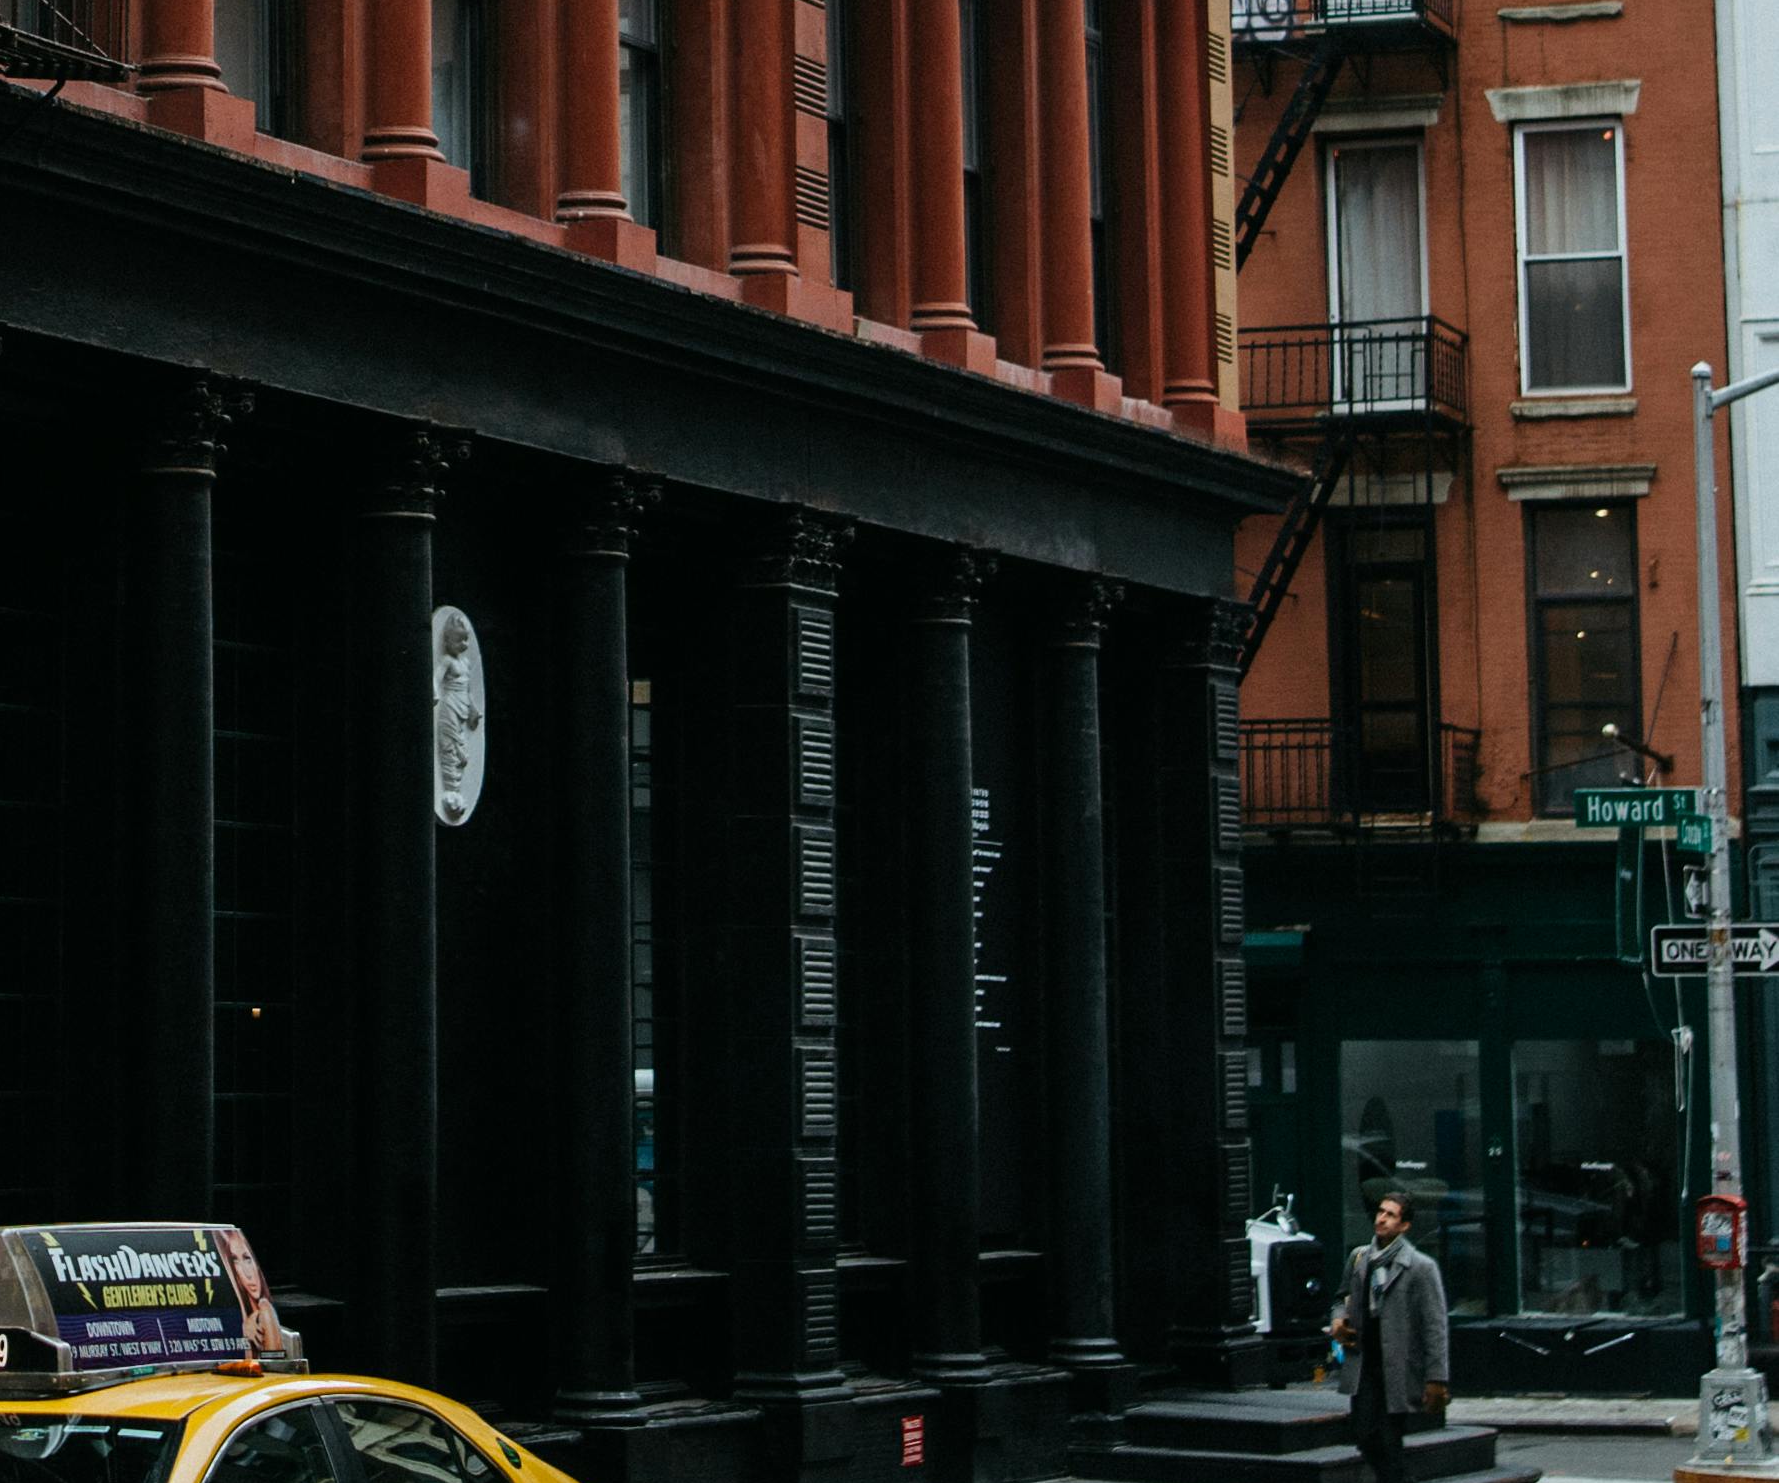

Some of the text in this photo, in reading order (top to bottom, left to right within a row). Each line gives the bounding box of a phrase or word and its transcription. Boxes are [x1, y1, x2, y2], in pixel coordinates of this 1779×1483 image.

[1587, 794, 1686, 822] Howard St
[1666, 941, 1777, 960] ONE WAY
[102, 1283, 198, 1309] GENTLEMEN'S CLUBS
[86, 1320, 135, 1338] DOWNTOWN
